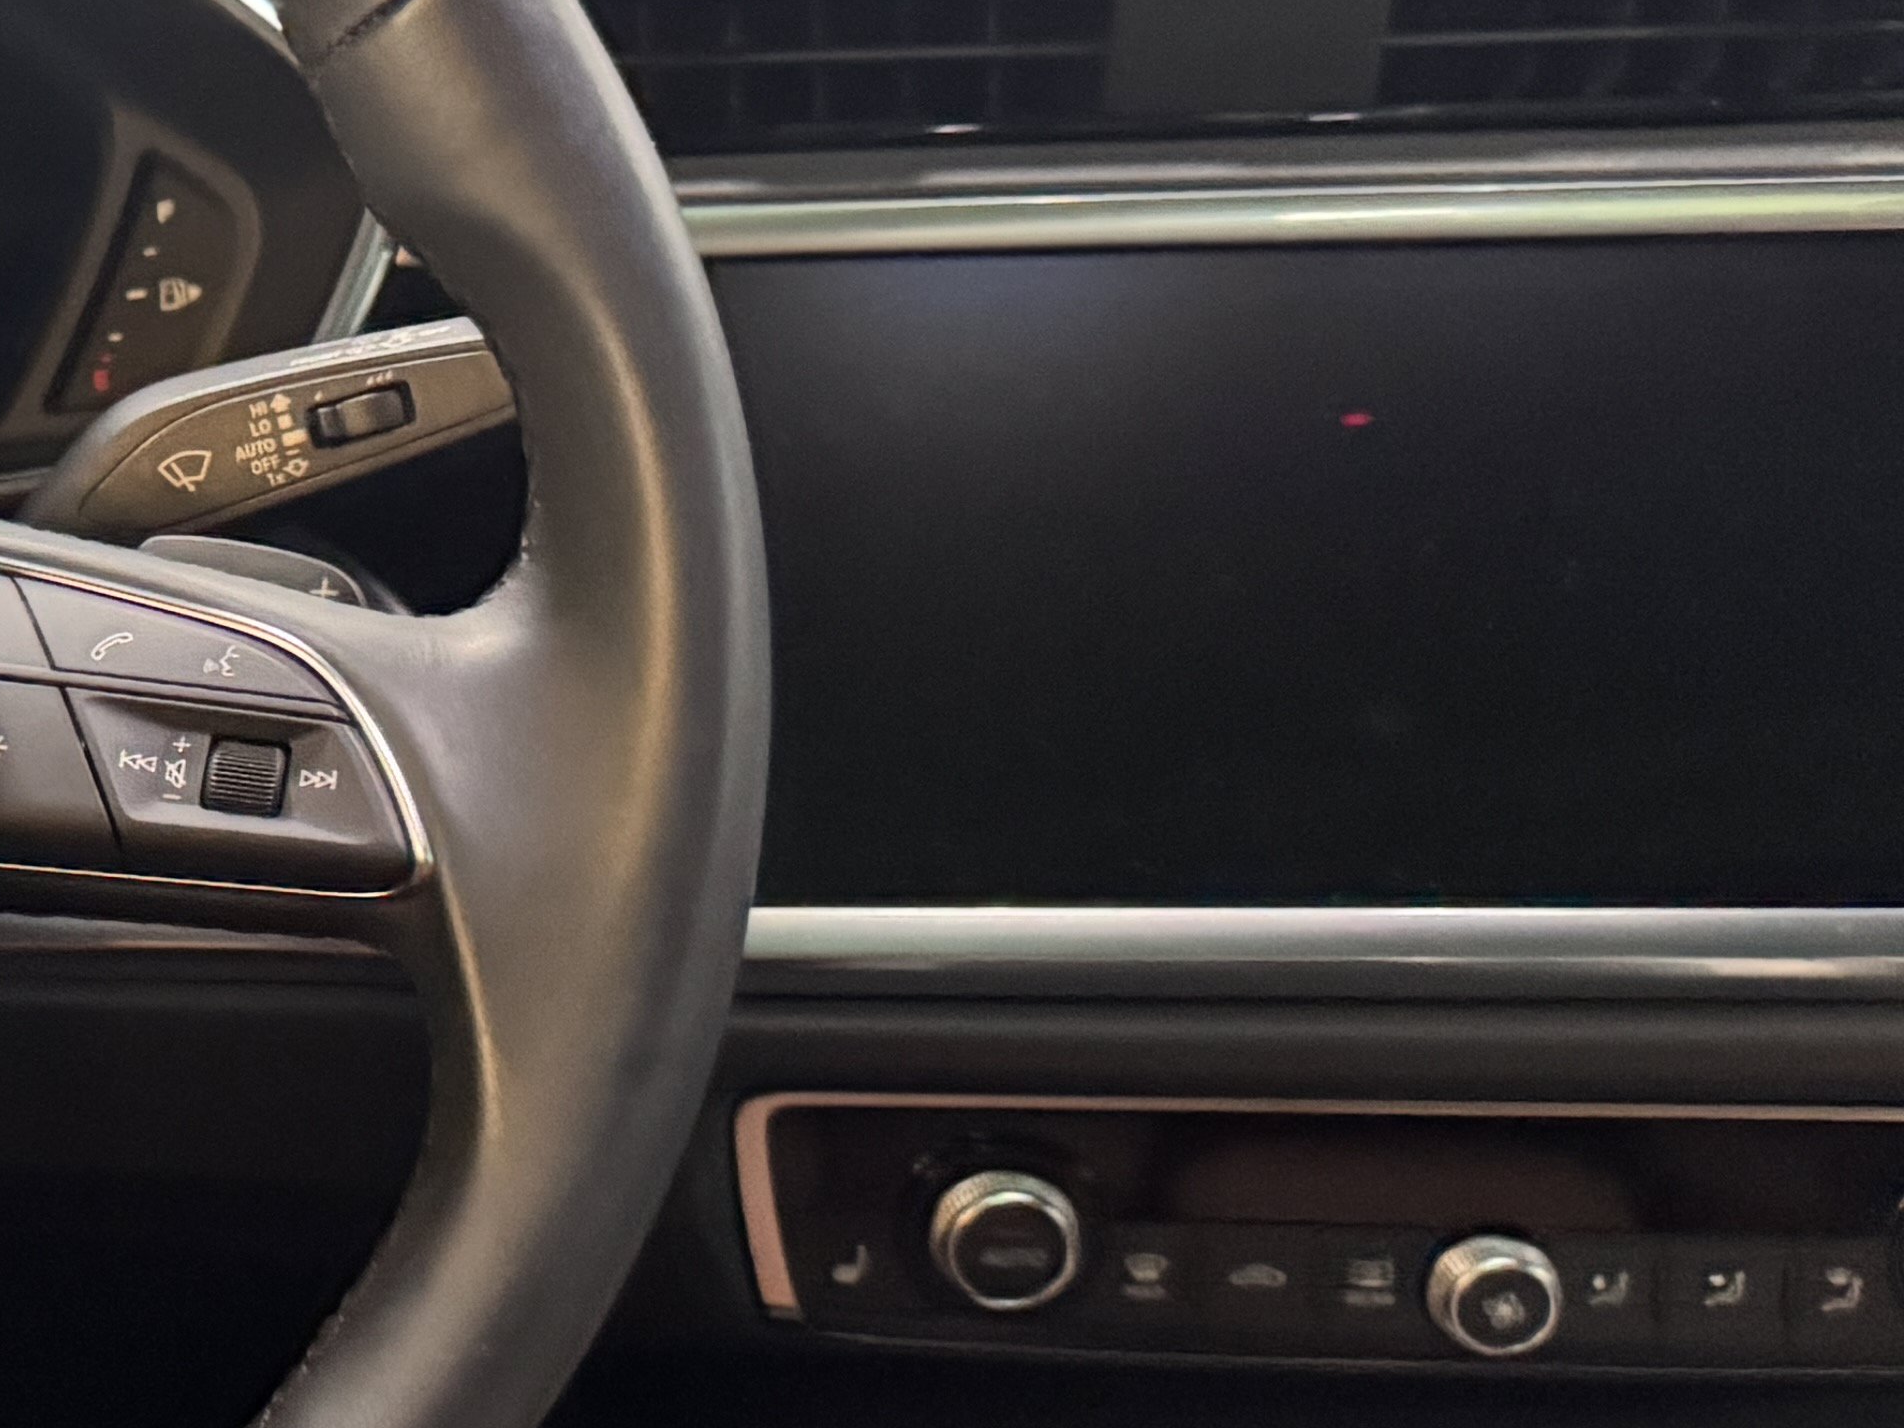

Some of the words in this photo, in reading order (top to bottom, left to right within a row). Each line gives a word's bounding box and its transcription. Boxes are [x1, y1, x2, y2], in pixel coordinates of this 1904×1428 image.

[248, 400, 268, 419] HI
[248, 419, 272, 437] LO
[235, 438, 277, 462] AUTO
[250, 454, 280, 475] OFF
